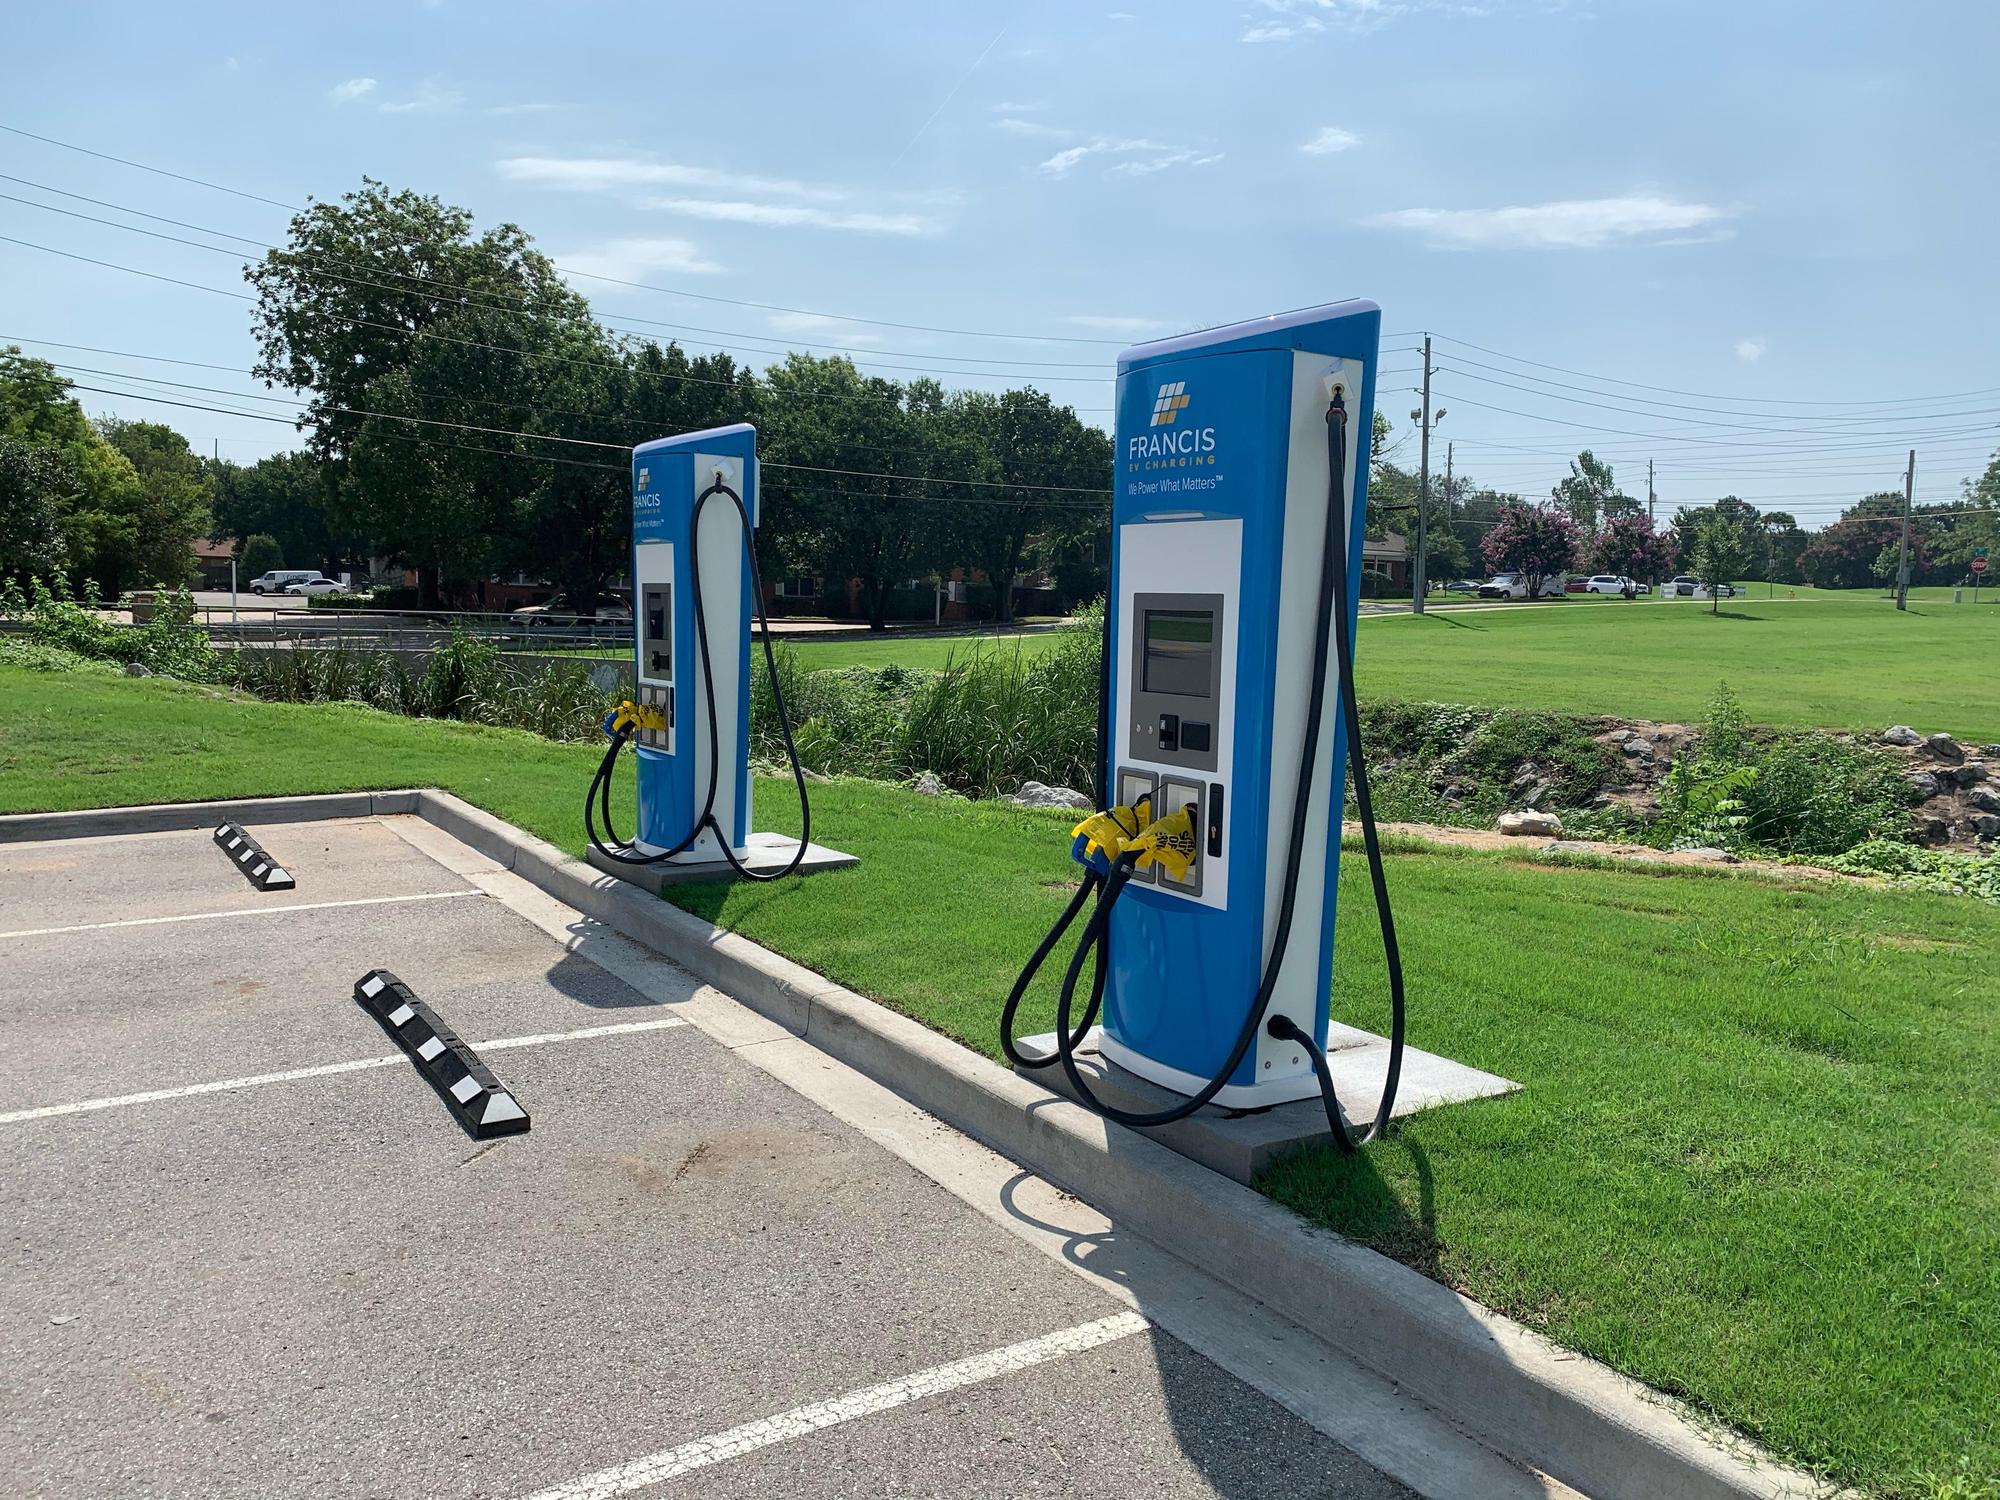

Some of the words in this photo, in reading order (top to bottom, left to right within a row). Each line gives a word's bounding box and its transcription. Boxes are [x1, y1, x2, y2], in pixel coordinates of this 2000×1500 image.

[1129, 427, 1216, 460] FRANCIS
[1129, 463, 1140, 472] EV
[1145, 455, 1215, 470] CHARGING
[1128, 483, 1138, 495] We
[1138, 481, 1159, 494] Power
[1160, 479, 1180, 492] What
[633, 493, 661, 508] RANCIS
